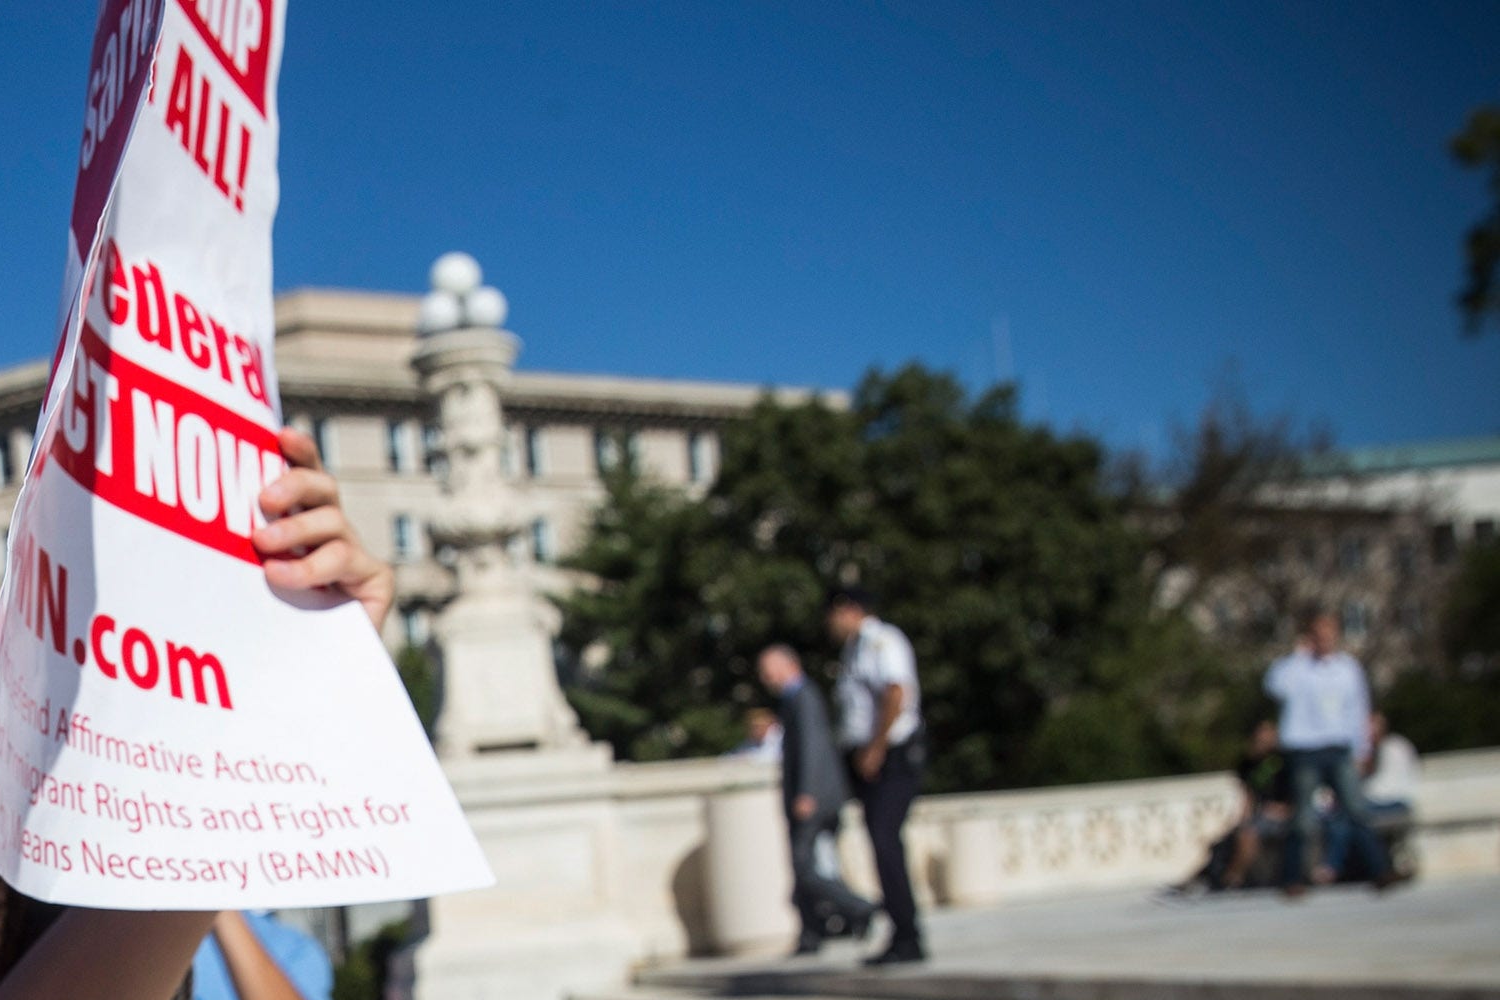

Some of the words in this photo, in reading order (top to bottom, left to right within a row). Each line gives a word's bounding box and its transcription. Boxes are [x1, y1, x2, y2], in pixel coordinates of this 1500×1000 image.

[165, 43, 252, 214] ALL!
[61, 340, 120, 478] CT
[55, 706, 203, 779] Affirmative
[214, 750, 327, 787] Action,
[94, 782, 193, 834] Rights
[202, 802, 264, 832] and
[269, 802, 360, 840] Fight
[363, 796, 411, 825] for
[80, 839, 248, 891] Necessary
[258, 846, 391, 887] (BAMN)
